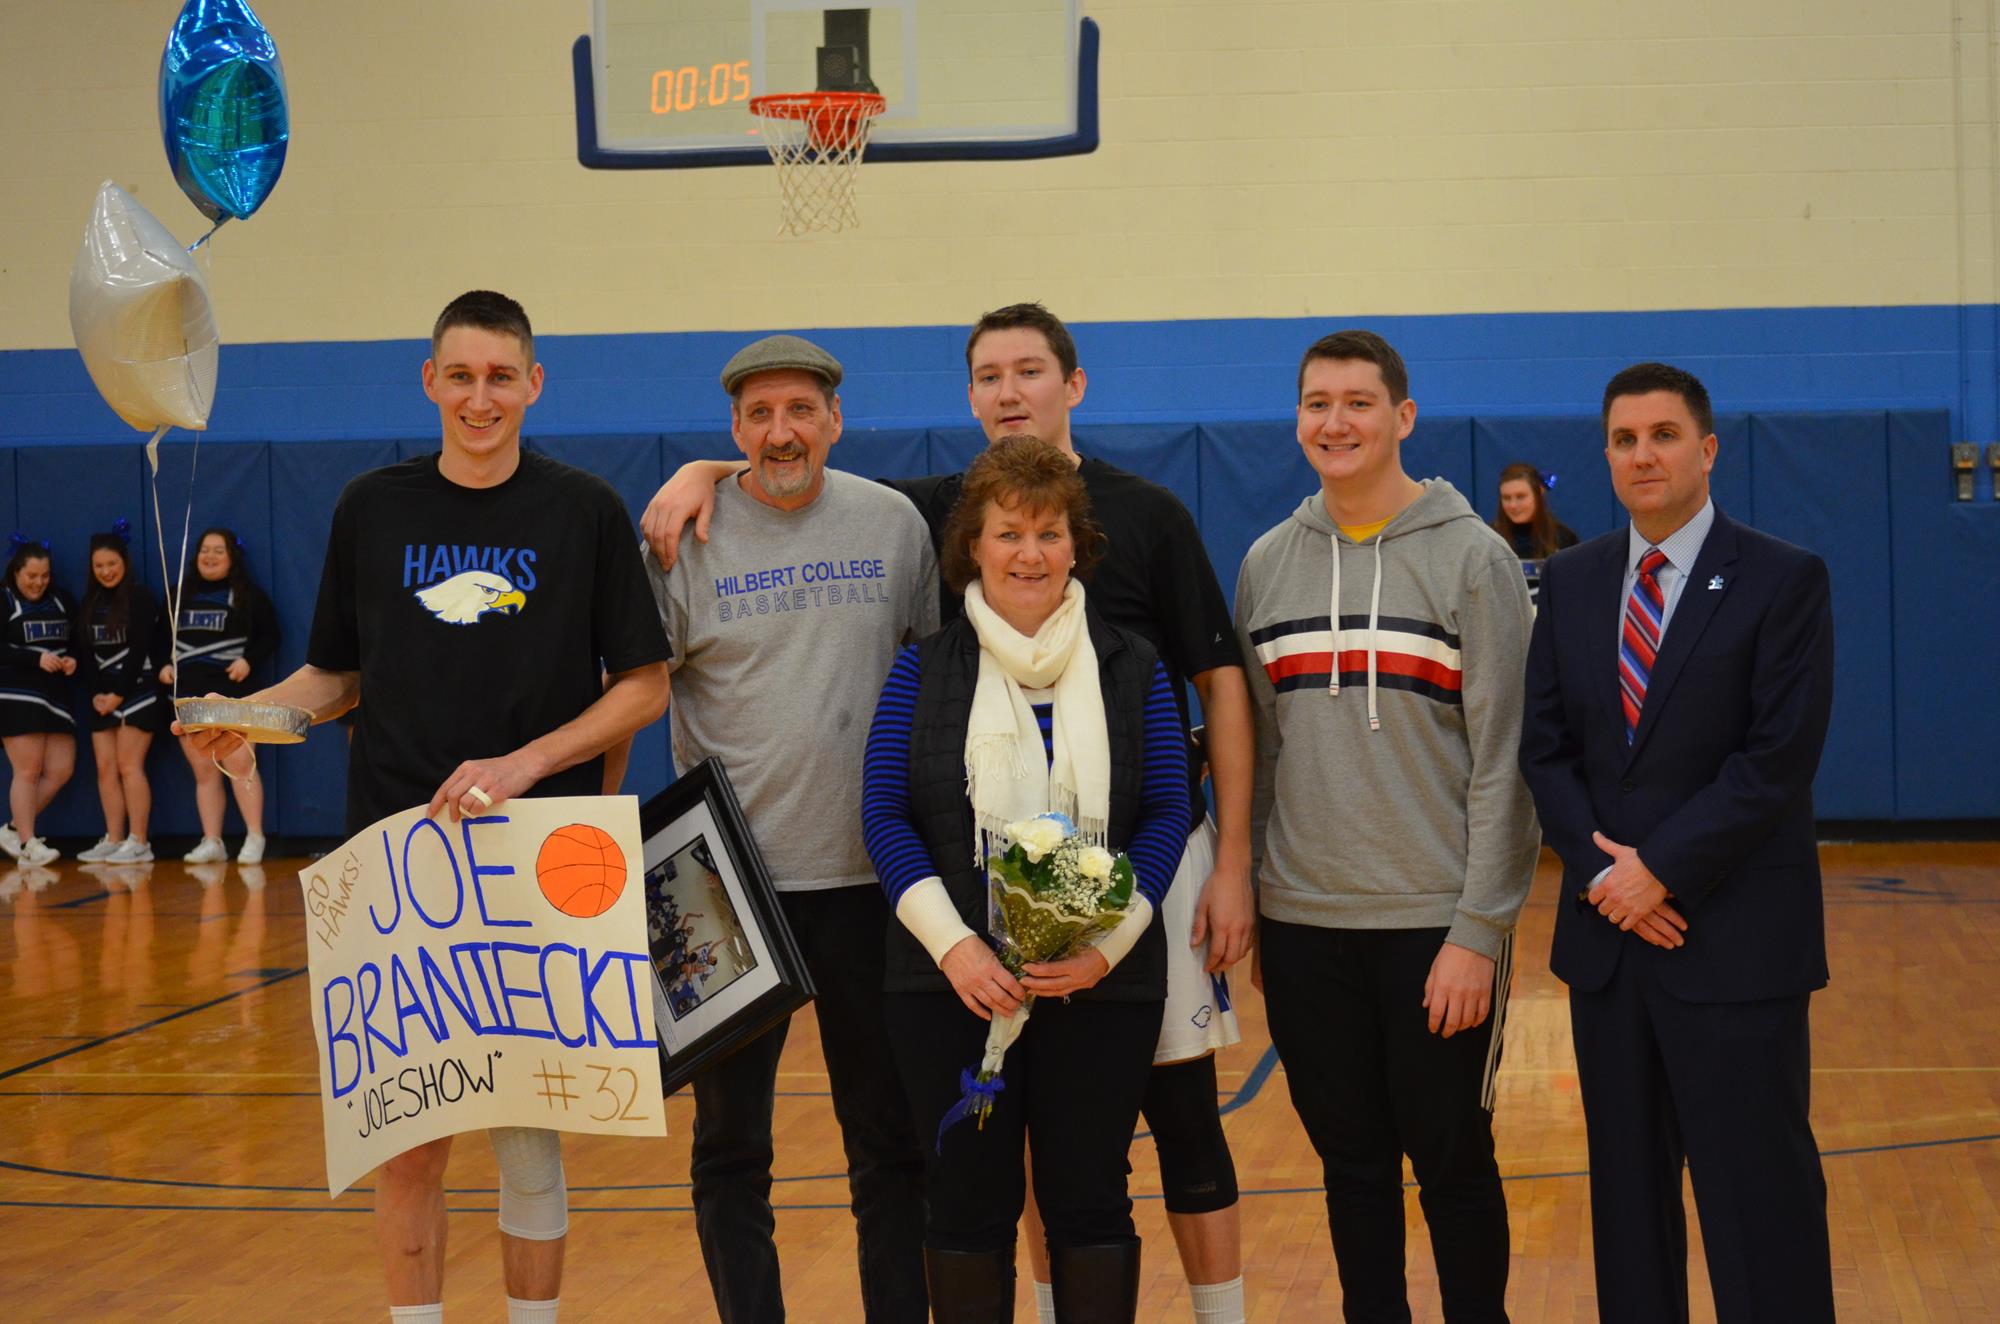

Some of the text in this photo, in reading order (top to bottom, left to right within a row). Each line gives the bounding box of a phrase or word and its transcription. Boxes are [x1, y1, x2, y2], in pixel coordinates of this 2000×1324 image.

[651, 60, 751, 115] 00:05
[403, 544, 537, 592] HAWKS
[715, 559, 886, 598] HILBERT COLLEGE
[718, 583, 889, 623] BASKETBALL
[307, 873, 330, 918] GO
[315, 851, 364, 951] HAWKS!
[369, 815, 533, 935] JOE
[323, 941, 659, 1099] BRANIECKI
[533, 1059, 650, 1122] #32
